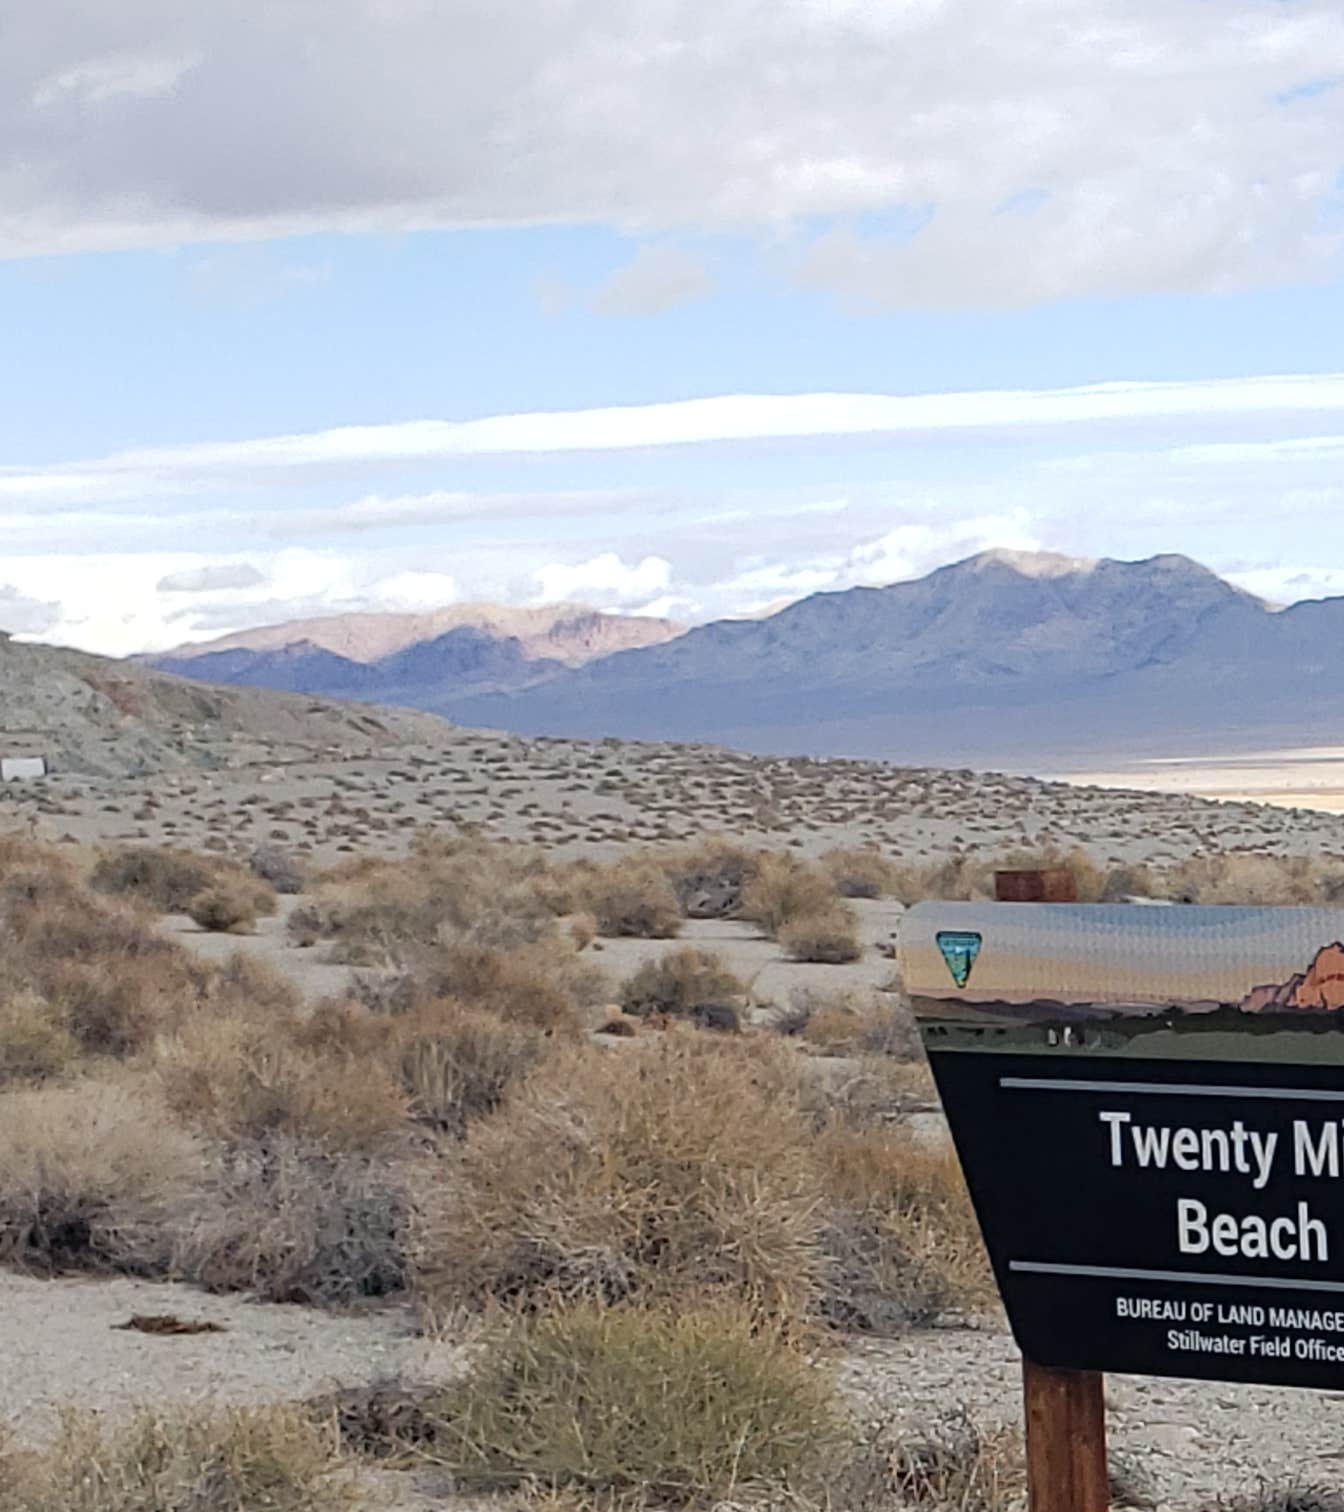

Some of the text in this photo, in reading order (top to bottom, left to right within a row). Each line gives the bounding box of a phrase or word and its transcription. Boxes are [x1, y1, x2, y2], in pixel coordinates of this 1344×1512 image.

[1099, 1112, 1278, 1188] Twenty
[1177, 1199, 1328, 1261] Beach
[1116, 1297, 1187, 1321] BUREAU
[1190, 1302, 1214, 1322] OF
[1217, 1304, 1265, 1326] LAND
[1167, 1329, 1246, 1355] Stillwater
[1250, 1335, 1291, 1358] Field
